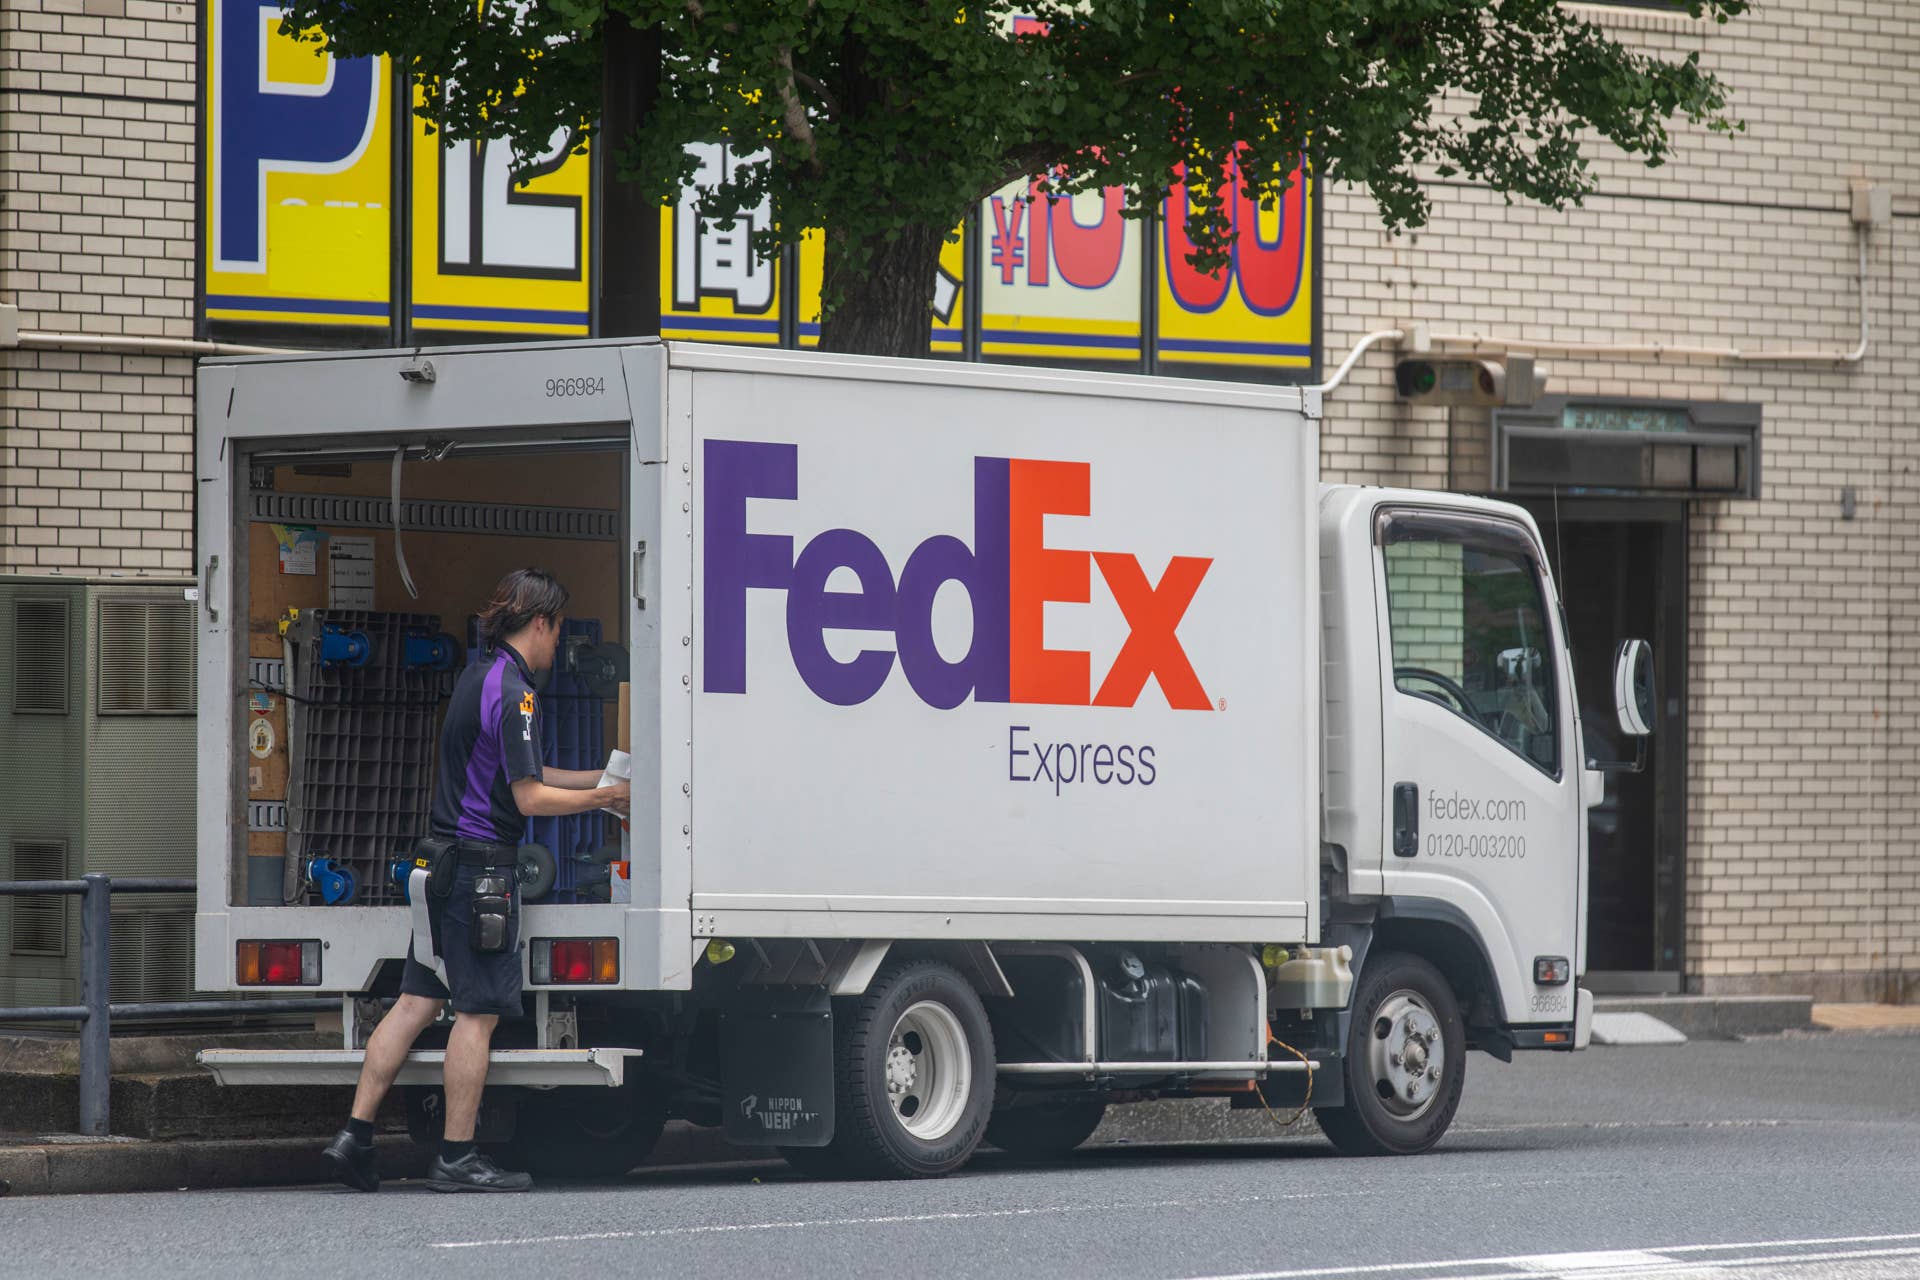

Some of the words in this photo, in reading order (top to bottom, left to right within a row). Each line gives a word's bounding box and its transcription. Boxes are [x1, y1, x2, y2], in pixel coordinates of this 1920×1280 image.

[213, 0, 381, 274] P
[545, 377, 605, 397] 966984
[703, 438, 1215, 711] FedEx
[1009, 725, 1156, 796] Express
[1428, 789, 1526, 821] fedex.com
[1427, 834, 1526, 858] 0120-003200
[768, 1097, 802, 1111] NIPPON
